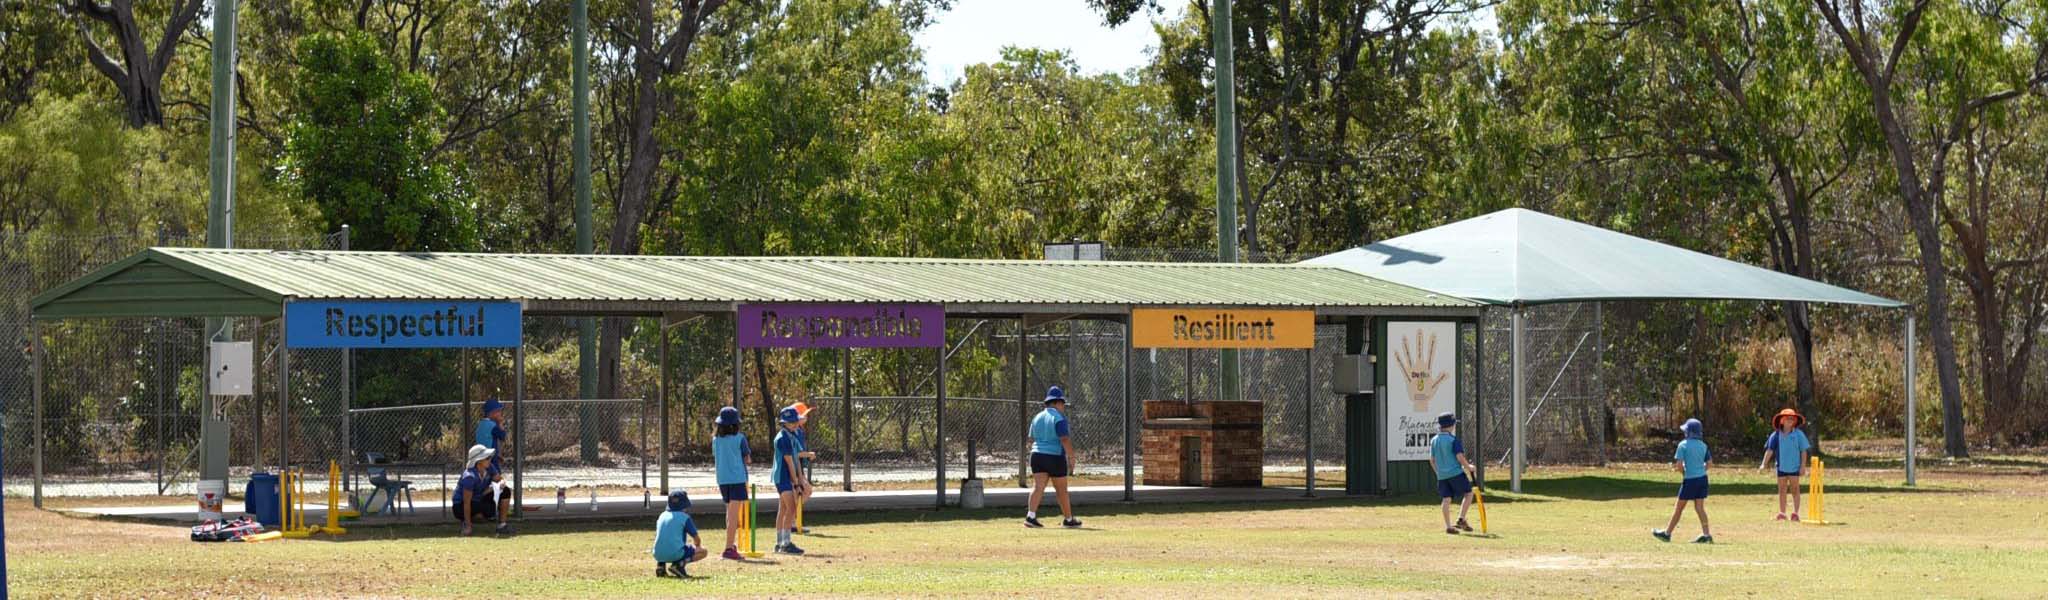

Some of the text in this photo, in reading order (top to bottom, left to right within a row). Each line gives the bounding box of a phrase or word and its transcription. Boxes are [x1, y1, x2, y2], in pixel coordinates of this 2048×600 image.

[325, 306, 485, 343] Respectful
[761, 308, 922, 343] Responsible
[1173, 313, 1275, 341] Resilient
